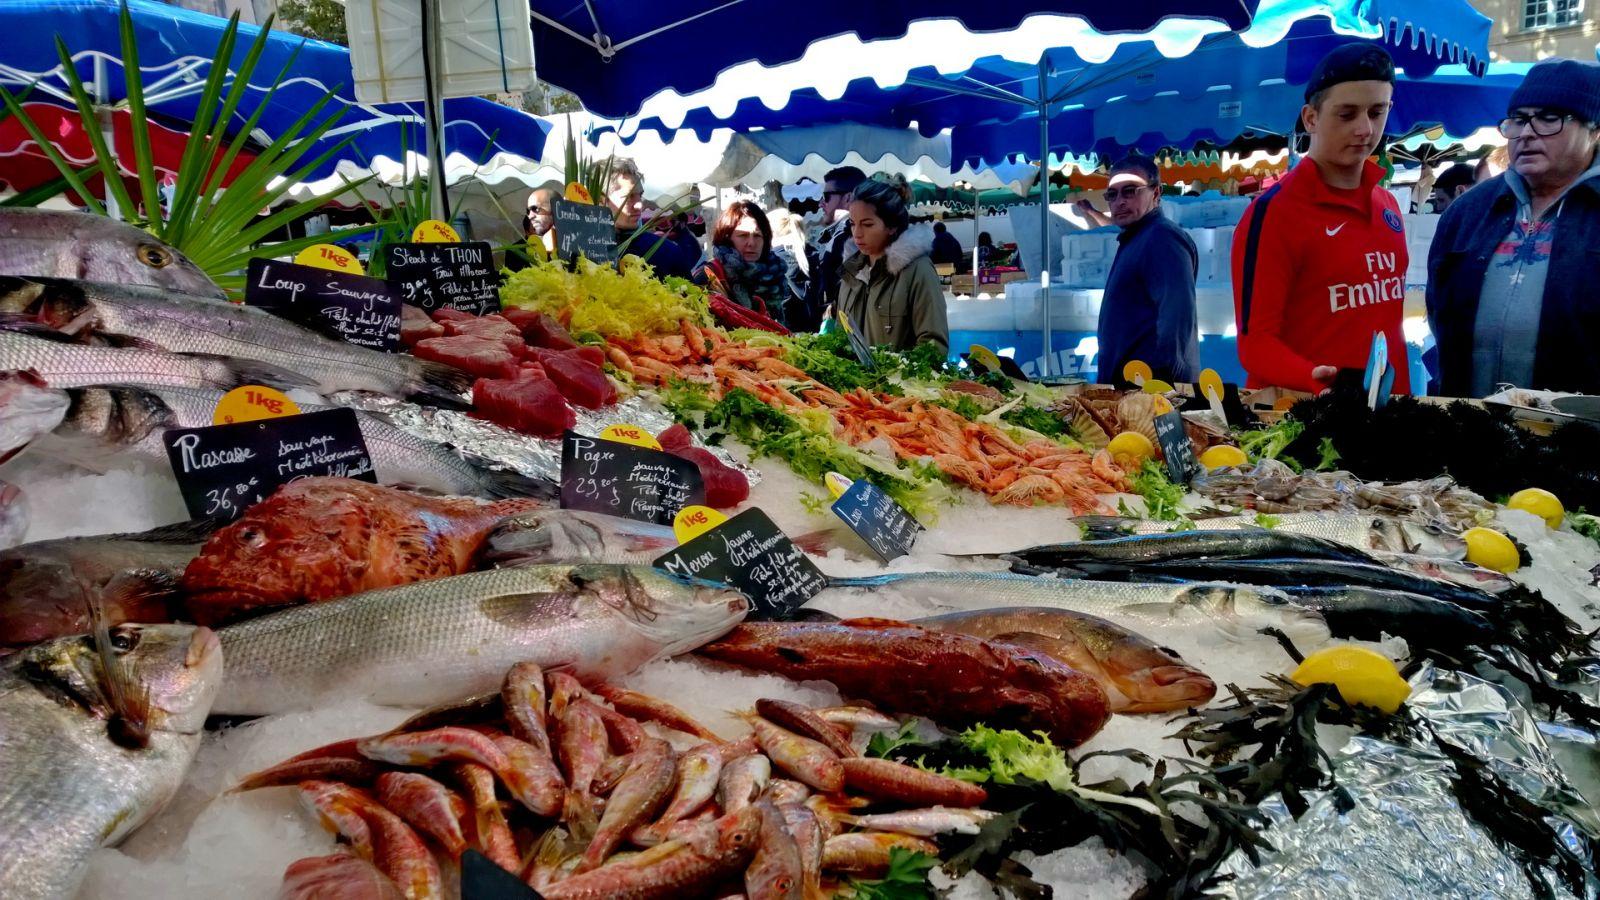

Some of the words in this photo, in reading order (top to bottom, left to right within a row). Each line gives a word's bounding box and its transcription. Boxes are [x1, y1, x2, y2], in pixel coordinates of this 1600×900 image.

[319, 247, 350, 268] 1kg
[431, 251, 442, 264] de
[444, 247, 482, 264] THON
[1365, 251, 1396, 273] Fly
[258, 265, 306, 302] Loup
[245, 390, 285, 414] 1kg
[611, 428, 641, 440] 1kg
[173, 434, 256, 473] Rascasse
[570, 438, 615, 475] Pagre
[680, 510, 709, 529] 1kg
